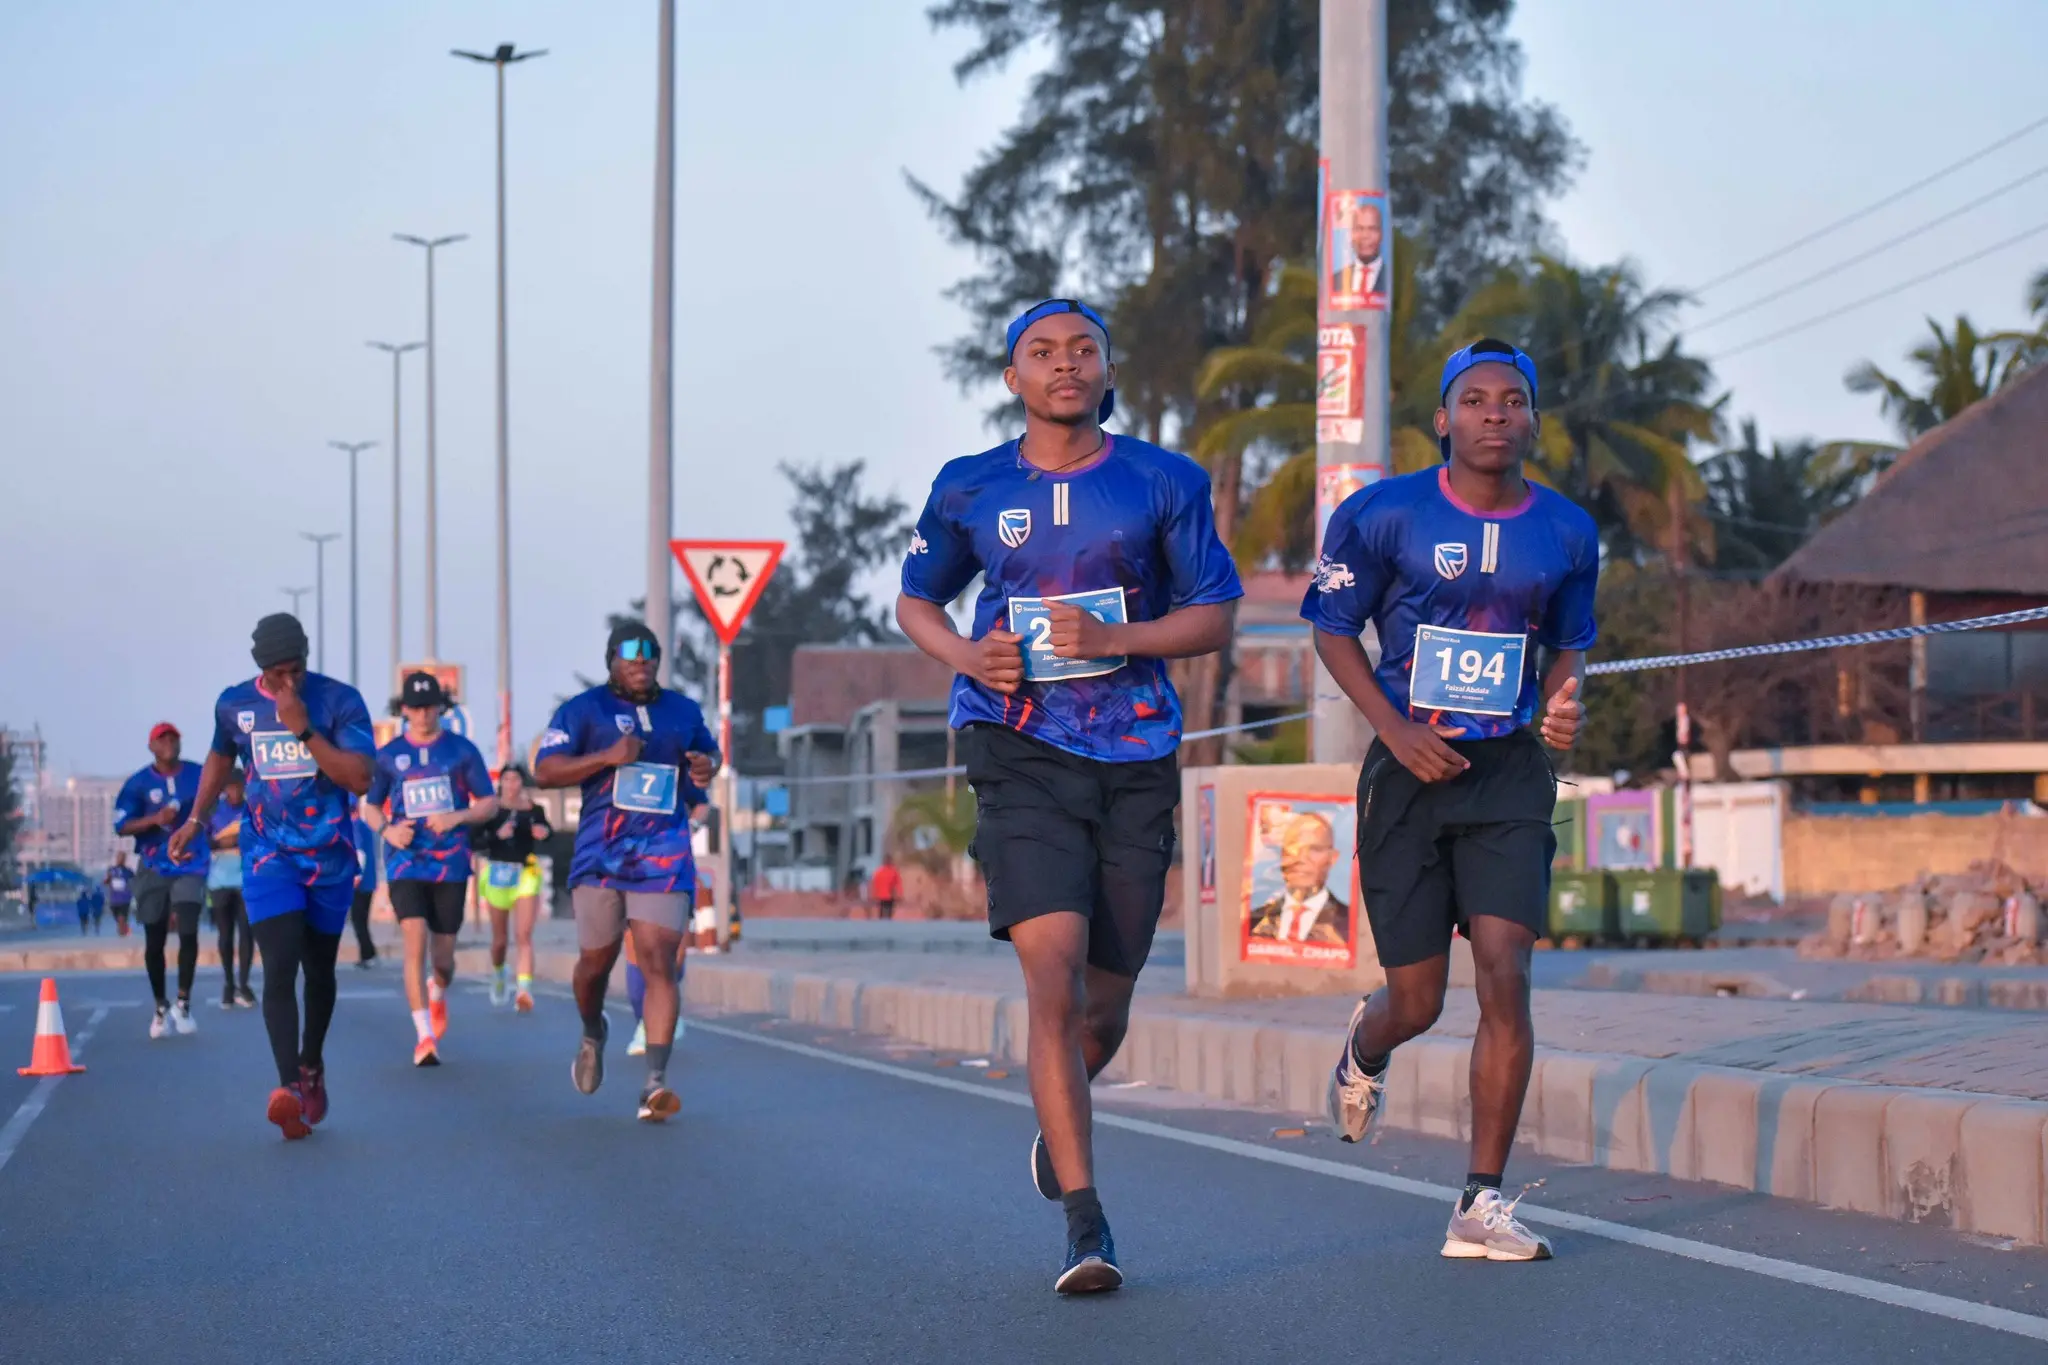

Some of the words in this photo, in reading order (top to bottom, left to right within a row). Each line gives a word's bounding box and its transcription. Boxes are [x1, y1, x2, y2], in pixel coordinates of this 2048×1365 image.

[1436, 647, 1505, 686] 194
[1445, 684, 1465, 692] Faizal
[641, 773, 656, 794] 7
